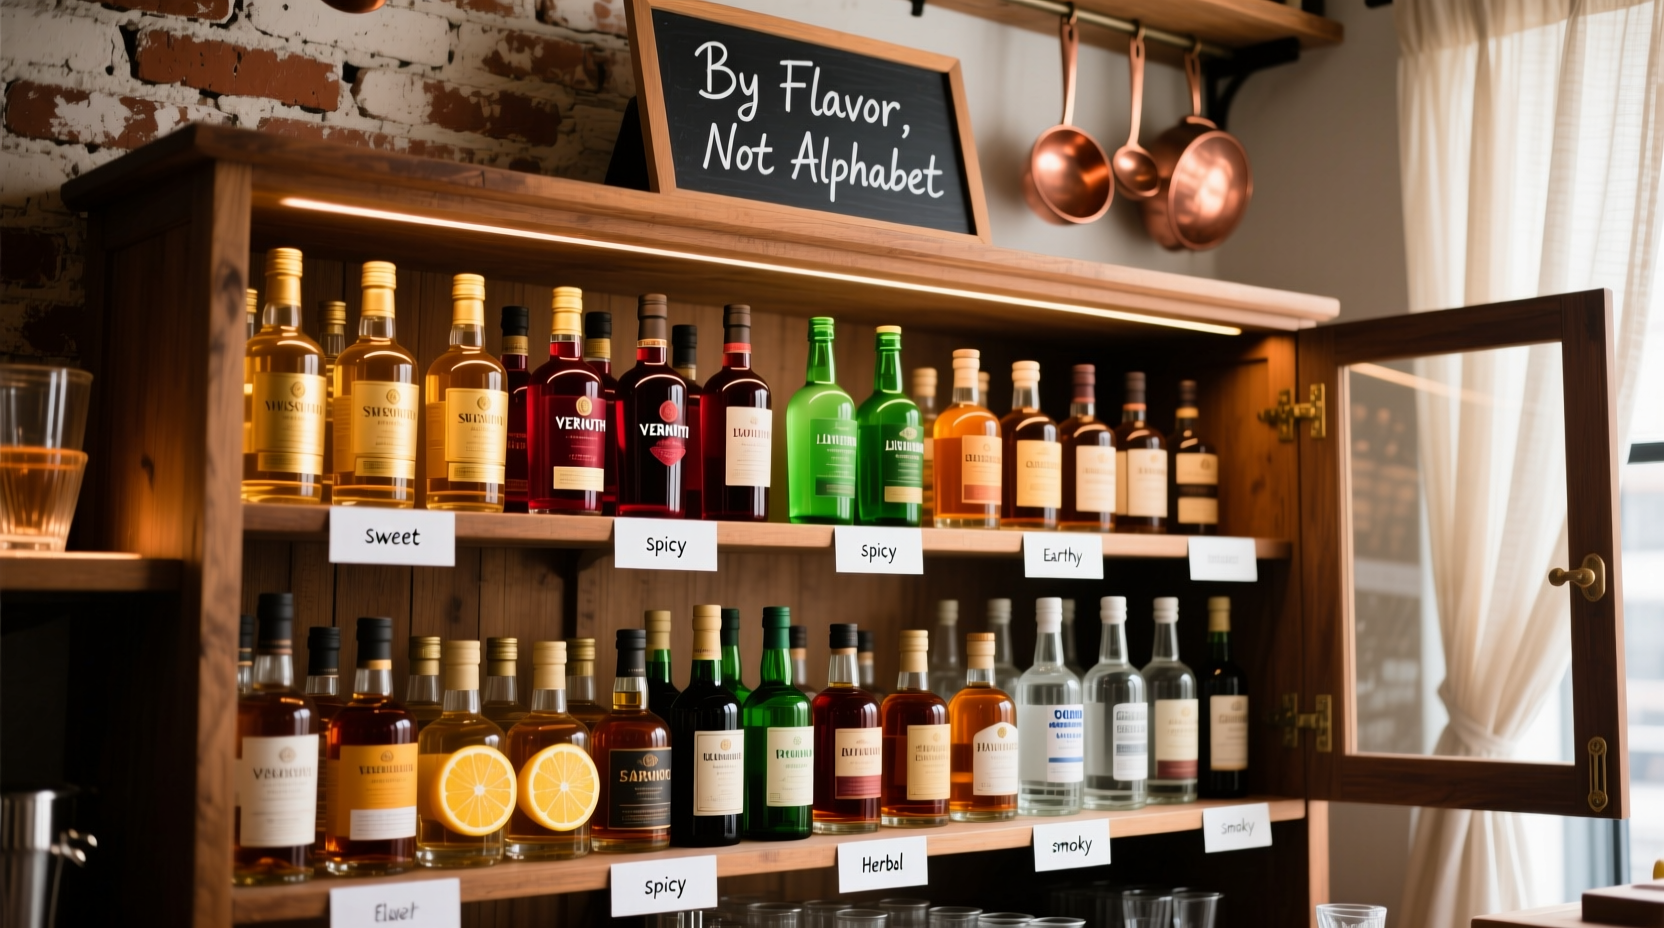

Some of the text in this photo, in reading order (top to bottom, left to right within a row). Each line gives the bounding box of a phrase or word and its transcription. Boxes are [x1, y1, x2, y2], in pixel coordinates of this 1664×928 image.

[694, 40, 911, 139] By Flavor,
[702, 122, 945, 203] Not Alphabet
[364, 528, 421, 546] Sweet
[646, 535, 687, 559] Spicy
[1043, 546, 1083, 568] Earthy
